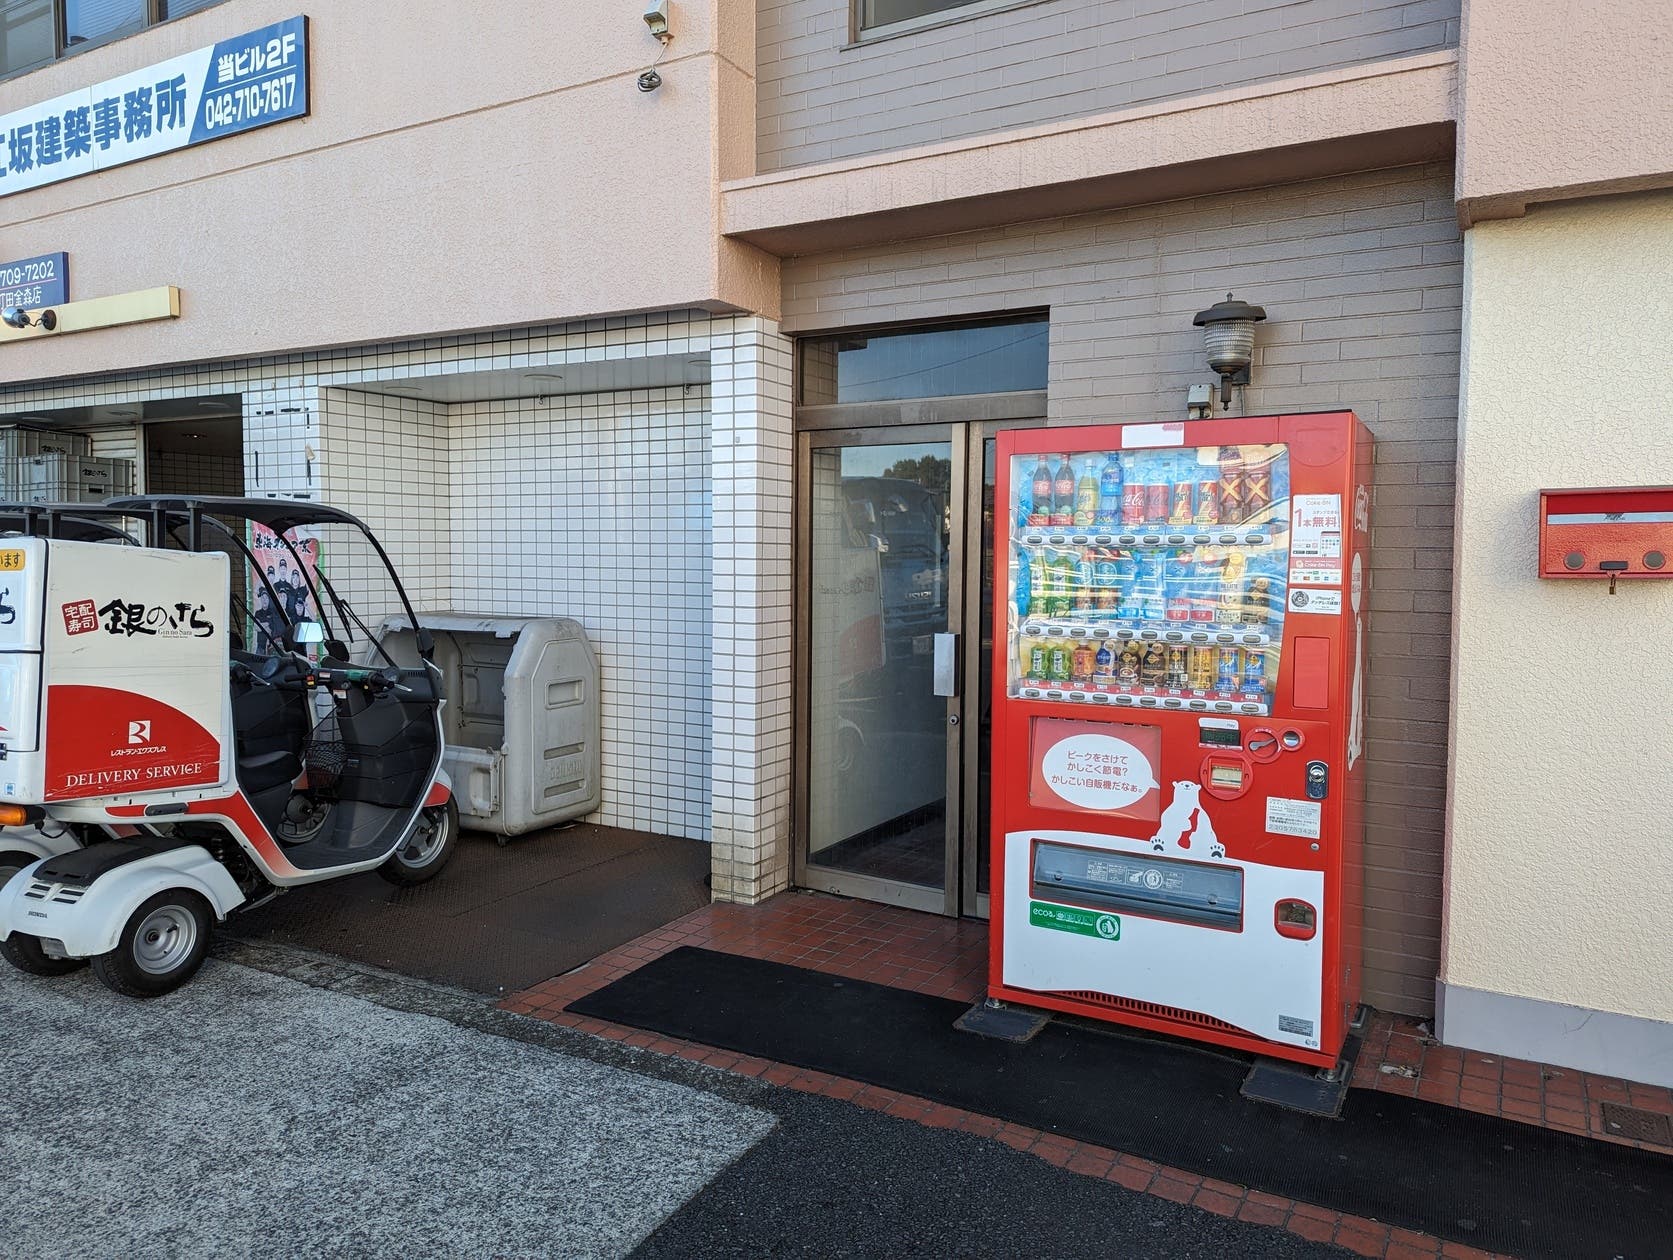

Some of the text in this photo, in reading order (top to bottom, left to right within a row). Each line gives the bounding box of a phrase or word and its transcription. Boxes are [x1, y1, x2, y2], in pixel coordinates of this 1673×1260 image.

[218, 32, 296, 84] 当ビル2F
[205, 73, 296, 130] 042-710-7617
[0, 552, 21, 568] ます
[64, 602, 95, 619] 宅配
[98, 598, 215, 638] 銀のさら
[67, 615, 96, 633] 寿司
[65, 762, 203, 788] DELIVERY SERVICE
[1066, 762, 1129, 776] かしこく節電?
